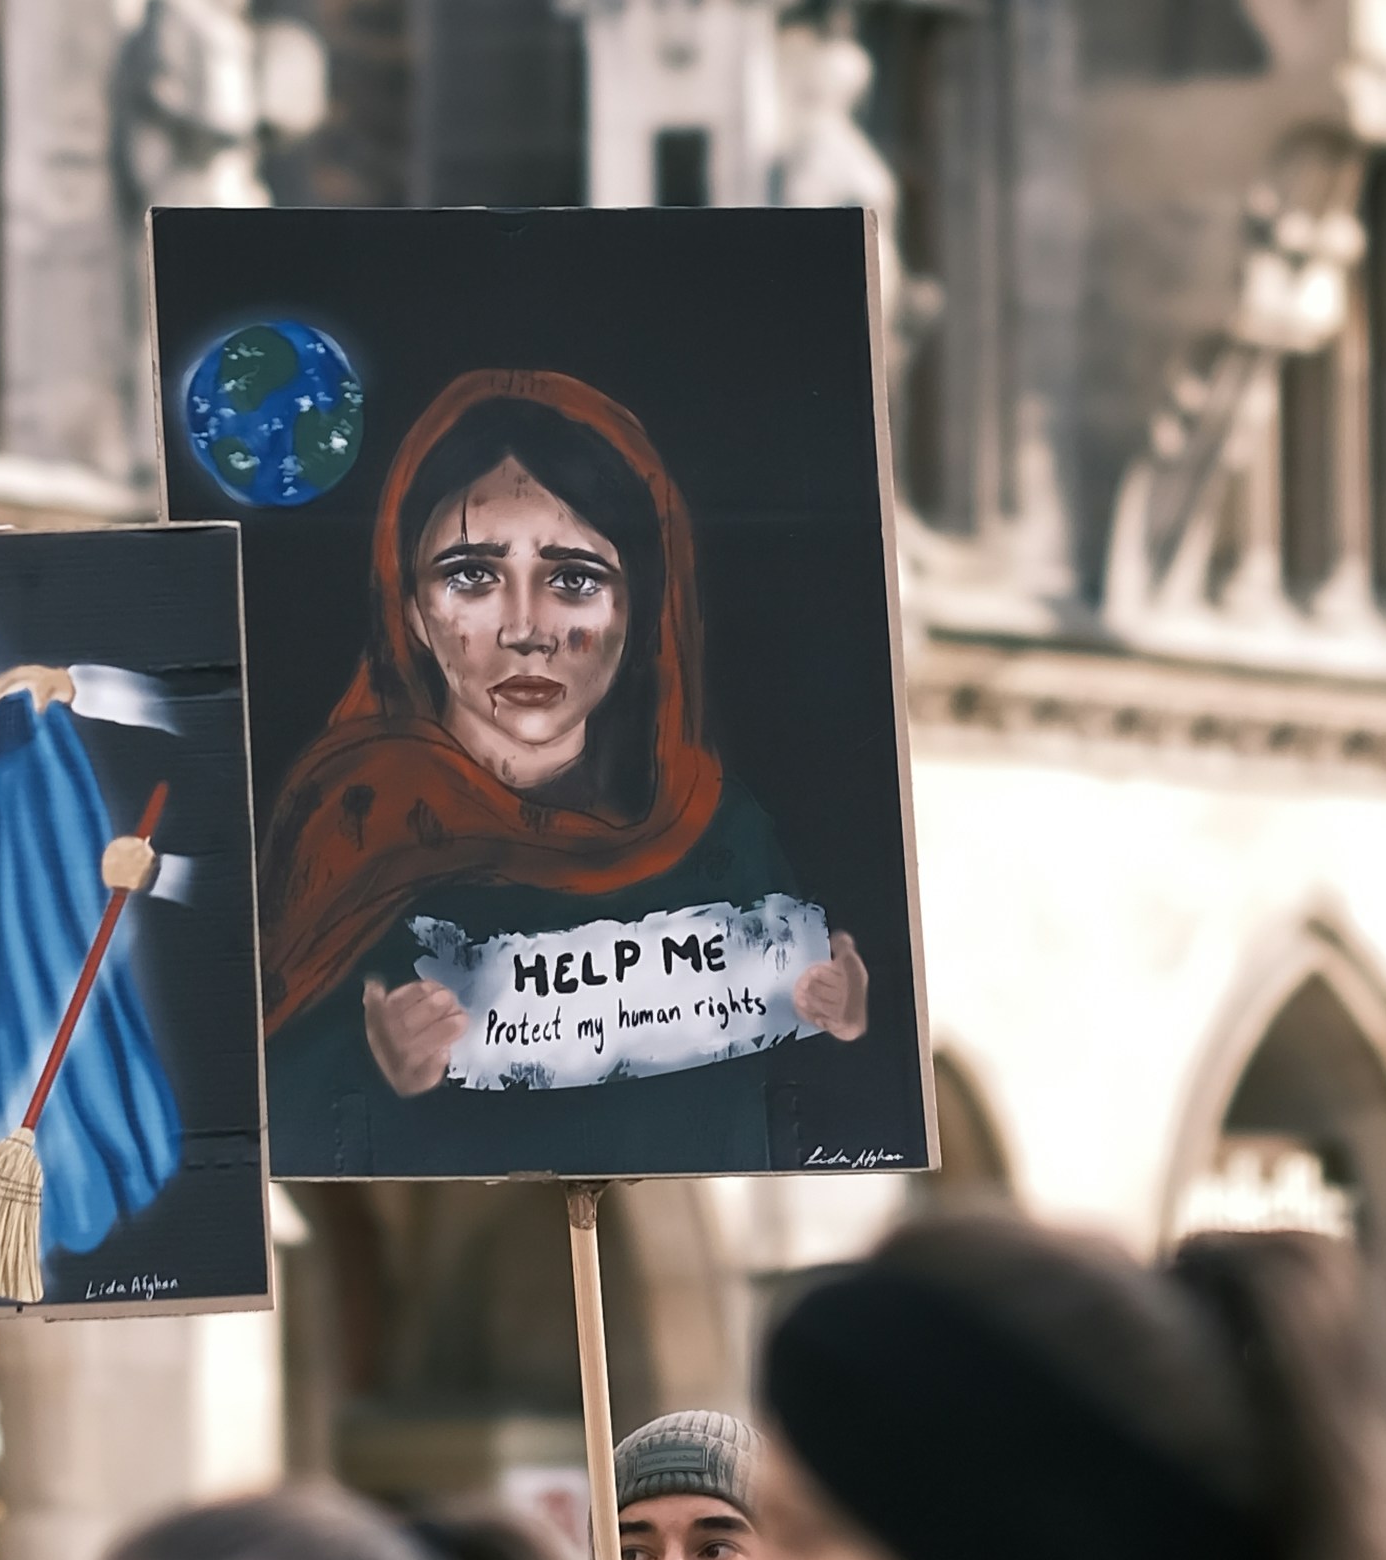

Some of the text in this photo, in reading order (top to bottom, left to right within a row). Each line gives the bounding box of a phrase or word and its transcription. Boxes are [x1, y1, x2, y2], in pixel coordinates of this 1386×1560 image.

[513, 933, 727, 997] HELP ME
[484, 986, 767, 1055] Protect my human rights
[85, 1280, 127, 1300] Lida
